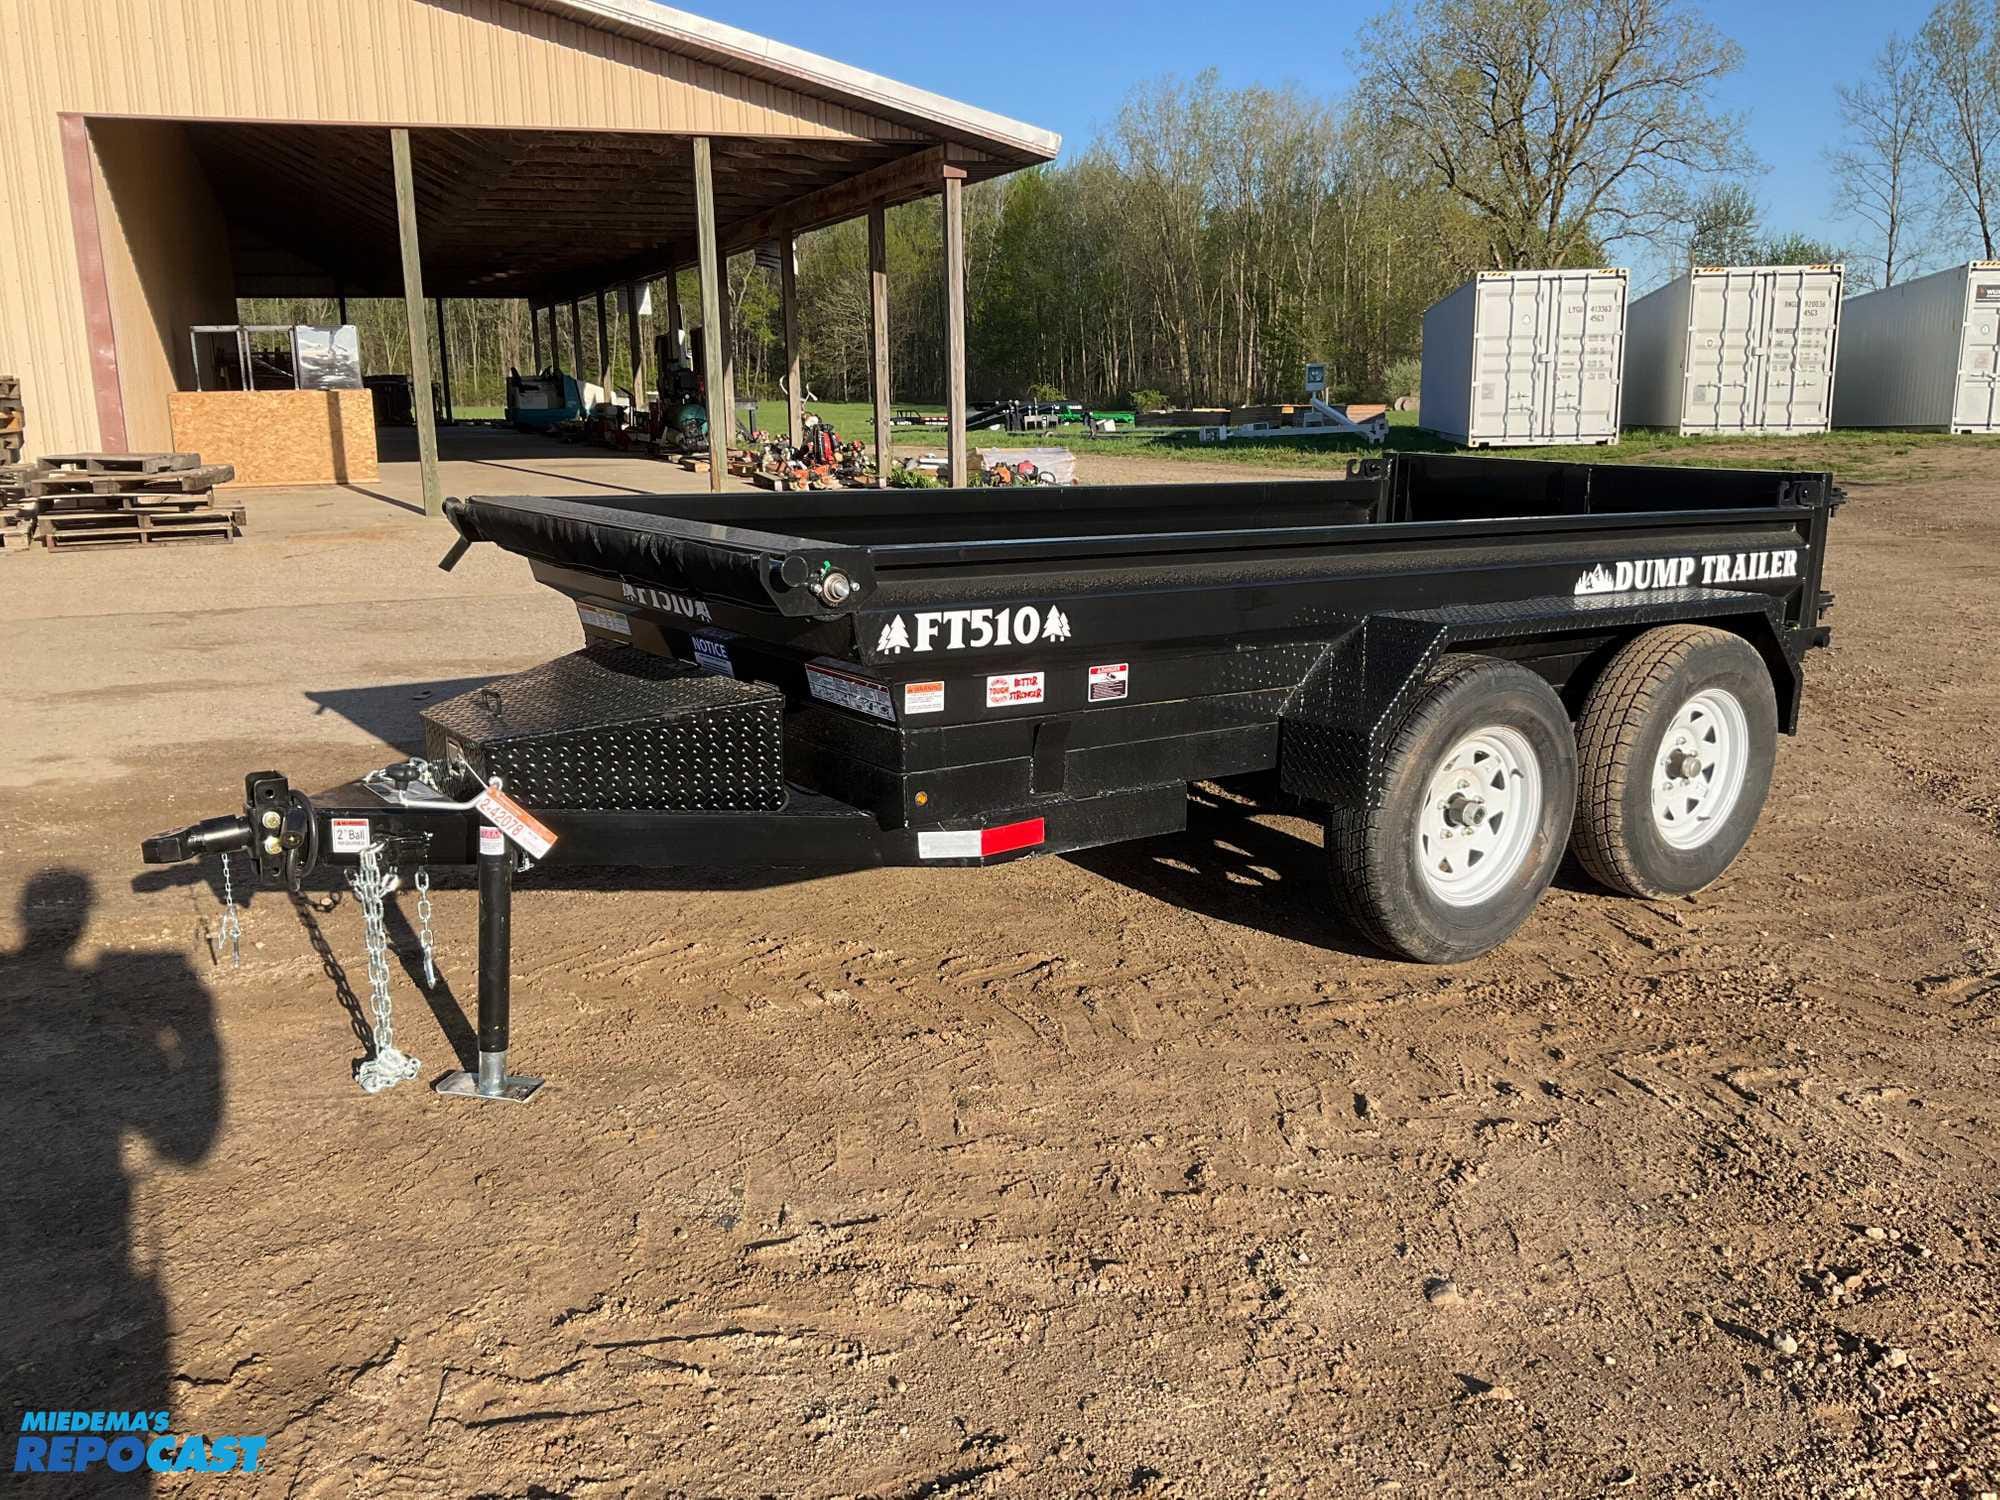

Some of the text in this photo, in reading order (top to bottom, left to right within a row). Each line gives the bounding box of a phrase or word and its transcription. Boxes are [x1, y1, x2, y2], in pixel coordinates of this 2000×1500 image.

[1615, 549, 1798, 592] DUMP TRAILER
[913, 605, 1041, 652] FT510
[692, 636, 728, 658] NOTICE
[1014, 675, 1039, 688] BETTER
[1009, 688, 1042, 701] STRONGER
[348, 829, 365, 841] Ball
